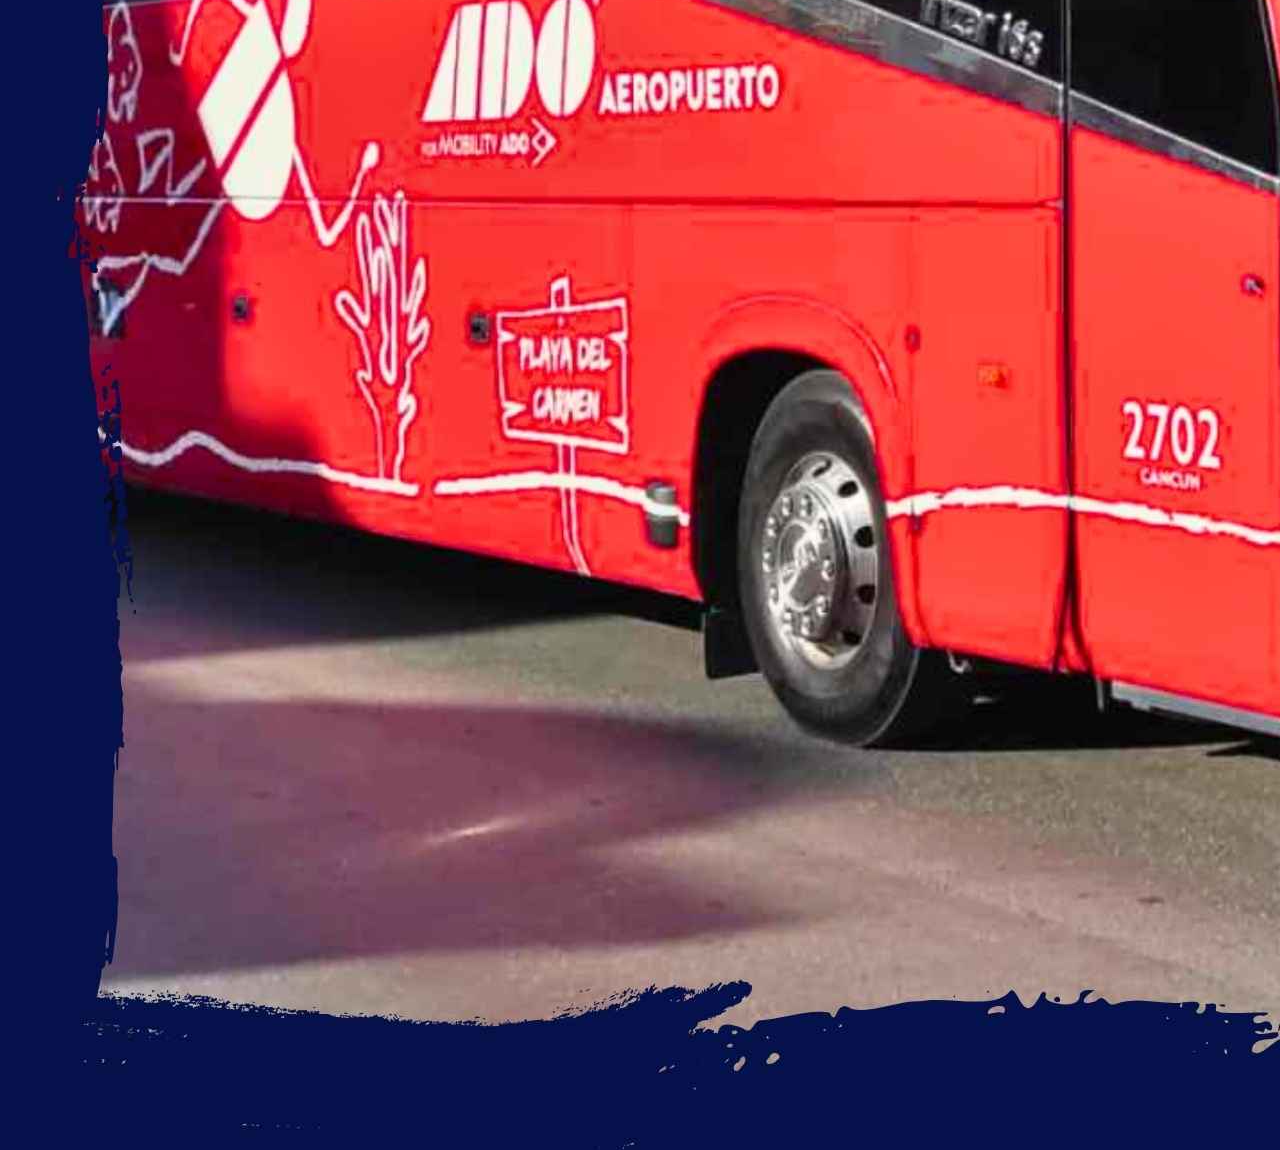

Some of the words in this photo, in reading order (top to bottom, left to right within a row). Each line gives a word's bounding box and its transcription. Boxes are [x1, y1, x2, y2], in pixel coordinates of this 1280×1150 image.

[599, 64, 779, 115] AEROPUERTO
[519, 337, 574, 373] PLAYA
[576, 337, 612, 370] DEL
[1122, 401, 1221, 469] 2702
